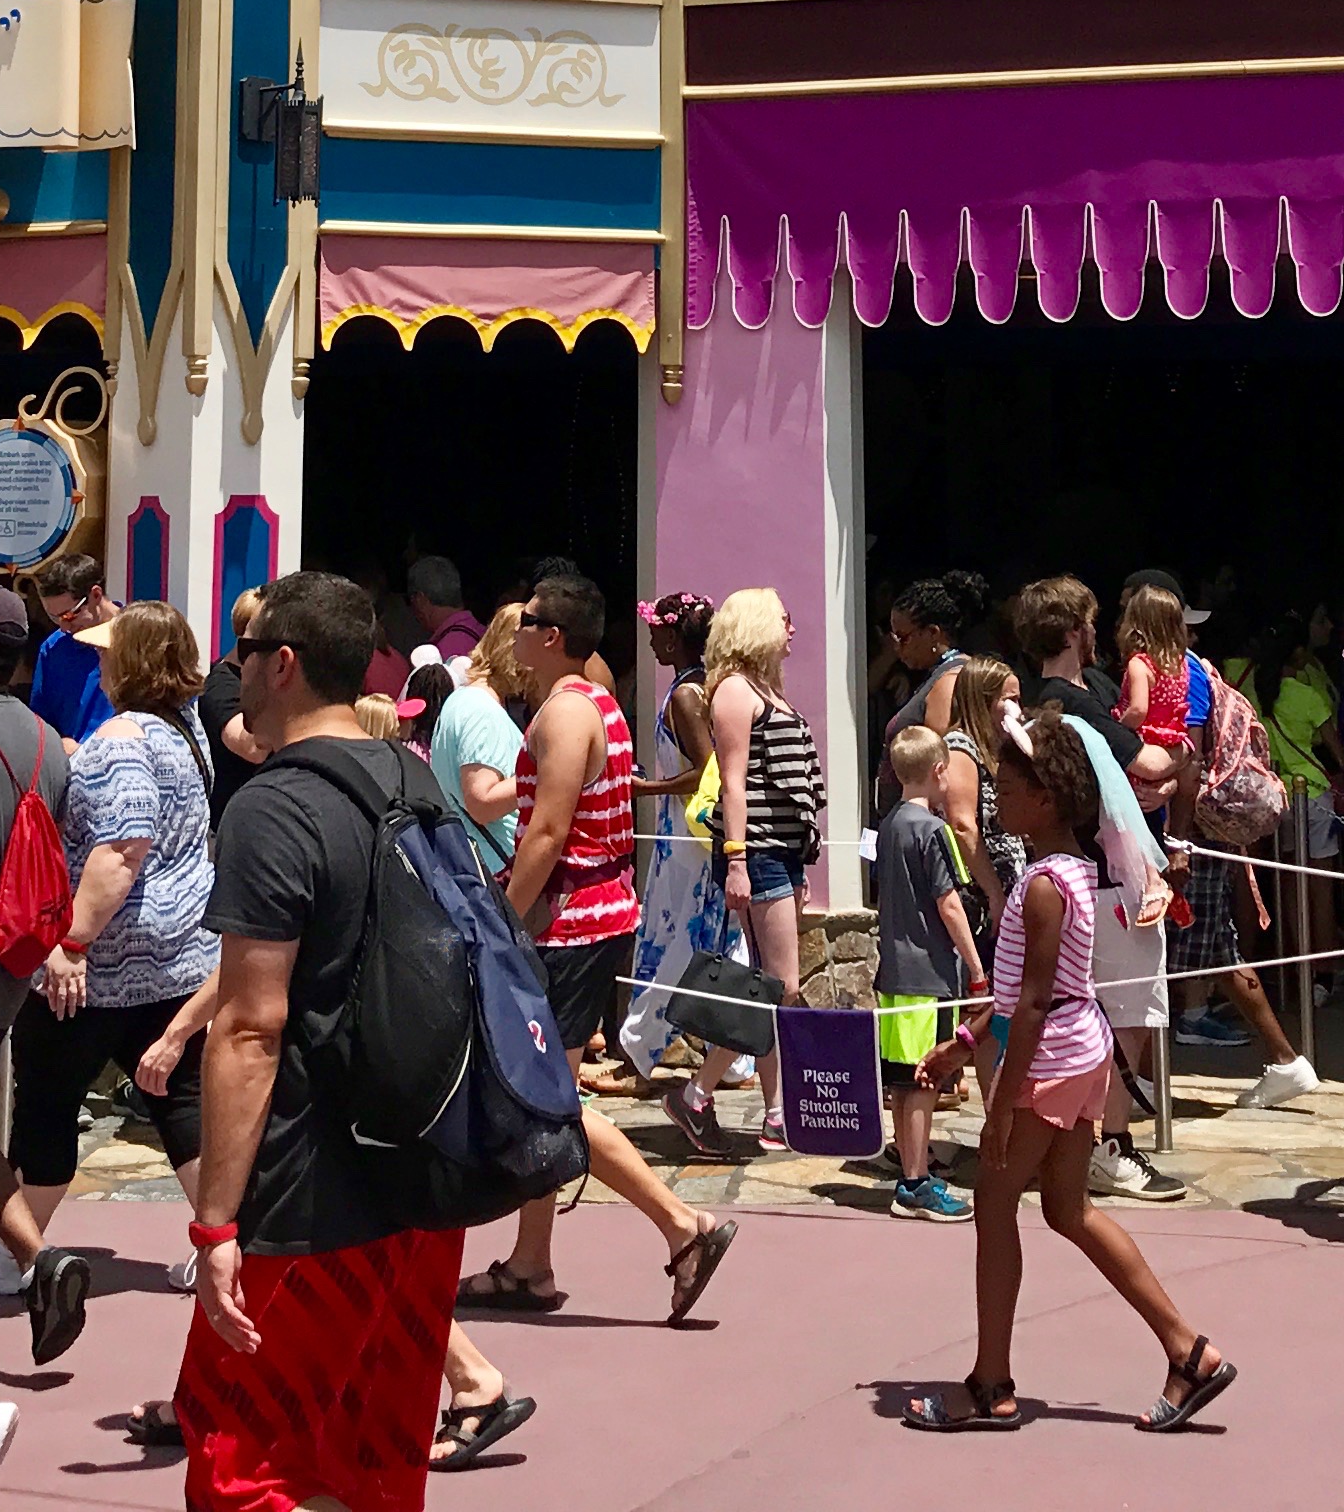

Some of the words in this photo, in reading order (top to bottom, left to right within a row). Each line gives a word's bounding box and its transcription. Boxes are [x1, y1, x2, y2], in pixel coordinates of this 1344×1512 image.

[803, 1068, 851, 1084] Please
[816, 1084, 839, 1099] No
[799, 1098, 859, 1114] Stroller
[801, 1114, 860, 1131] Parking
